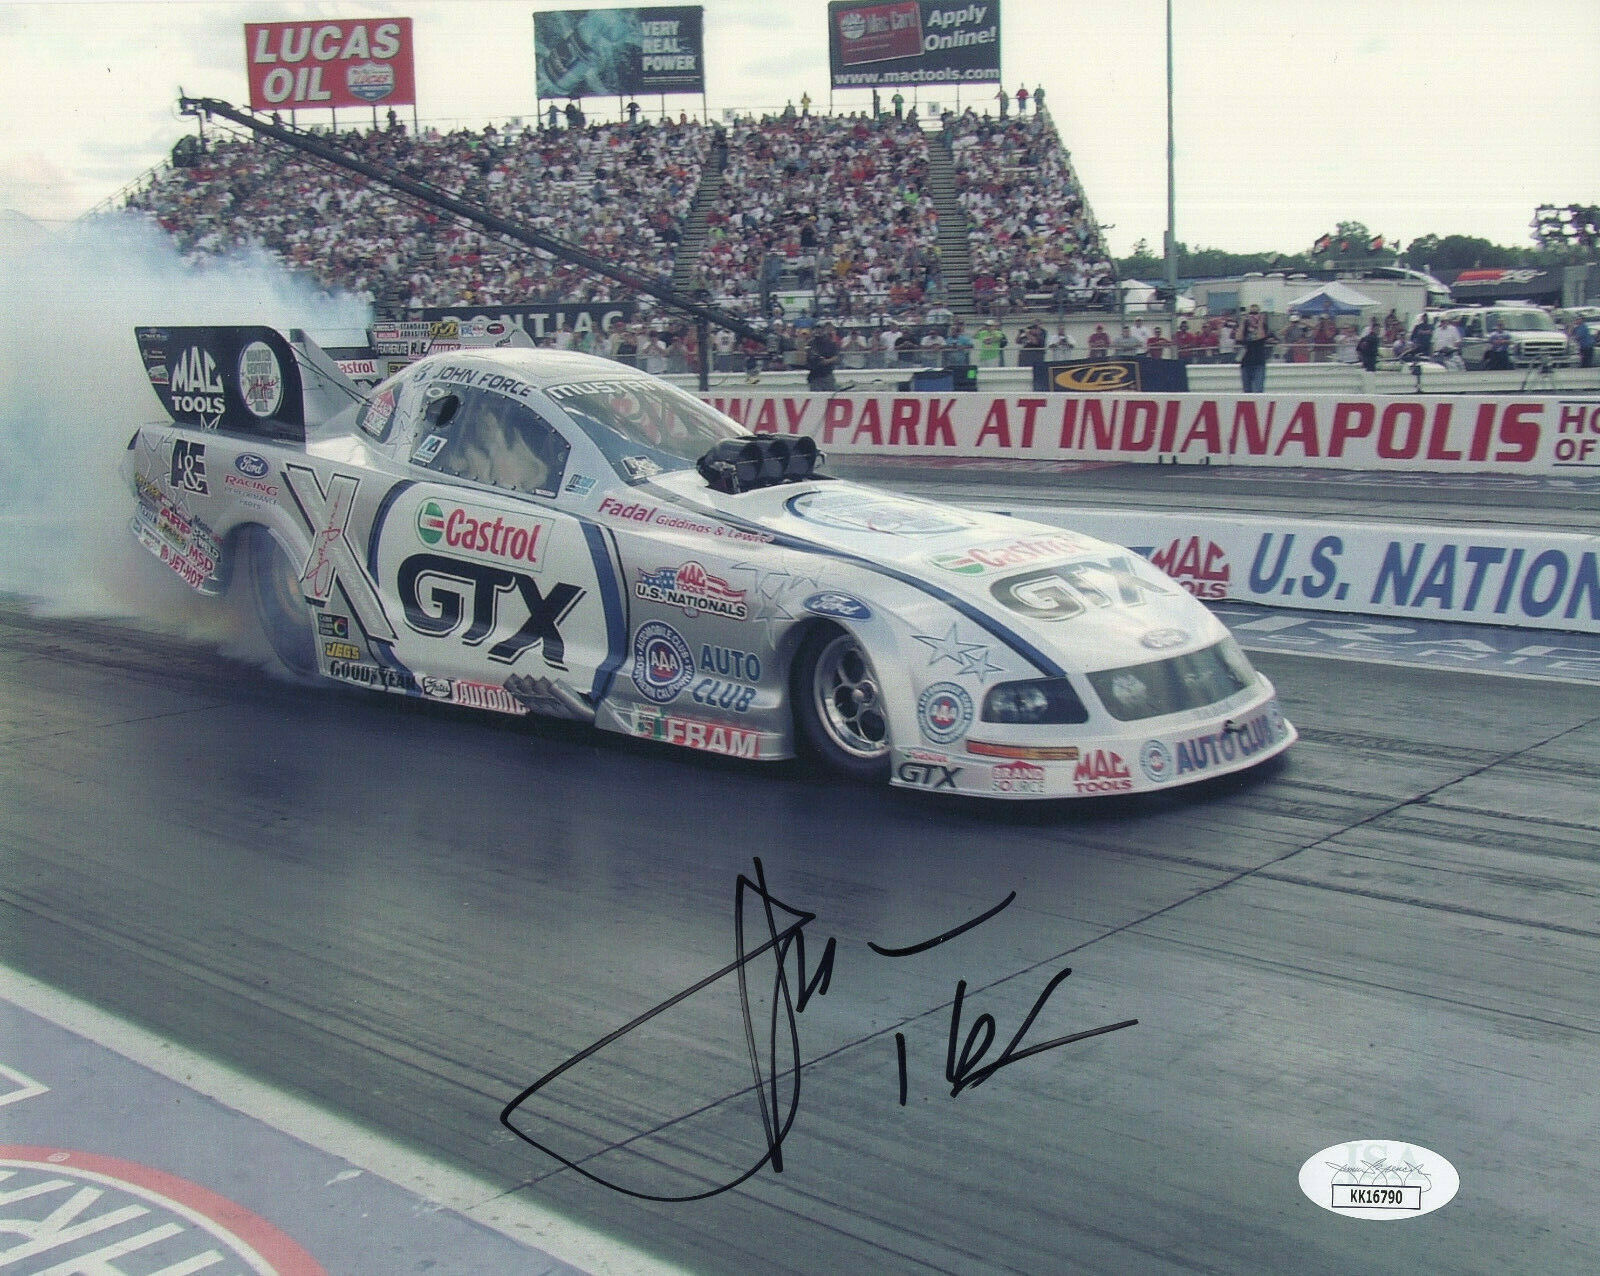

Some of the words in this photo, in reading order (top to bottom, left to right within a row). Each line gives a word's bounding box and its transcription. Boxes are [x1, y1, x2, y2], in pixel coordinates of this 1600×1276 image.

[641, 21, 680, 36] VERY
[927, 4, 988, 29] Apply
[254, 23, 401, 63] LUCAS
[642, 37, 681, 53] REAL
[924, 26, 997, 51] Online!
[642, 55, 697, 71] POWER
[833, 67, 1000, 85] www.mactools.com
[262, 67, 332, 103] OIL
[171, 345, 225, 393] MAC
[336, 361, 376, 374] astrol
[432, 365, 480, 384] JOHN
[478, 372, 536, 398] FORCE
[171, 395, 226, 415] TOOLS
[701, 399, 812, 434] WAY
[823, 399, 956, 446] PARK
[975, 399, 1047, 448] AT
[1060, 400, 1545, 462] INDIANAPOLIS
[1555, 438, 1598, 462] OF
[239, 455, 265, 476] Ford
[225, 474, 280, 497] RACING
[598, 497, 657, 522] Fadal
[655, 514, 711, 535] Giddings
[446, 508, 542, 563] Castrol
[188, 542, 214, 572] MSD
[676, 564, 706, 587] MAC
[1151, 535, 1230, 582] MAC
[1249, 532, 1350, 600] U.S.
[1370, 541, 1600, 620] NATION
[397, 553, 588, 672] GTX
[637, 583, 663, 600] U.S.
[667, 591, 747, 617] NATIONALS
[325, 642, 360, 660] JEGS
[650, 651, 679, 672] AAA
[700, 644, 761, 681] AUTO
[693, 678, 757, 712] CLUB
[667, 718, 759, 759] FRAM
[1175, 730, 1235, 776] AUTO
[898, 761, 963, 789] GTX
[1073, 749, 1131, 781] MAC
[1074, 779, 1132, 793] TOOLS
